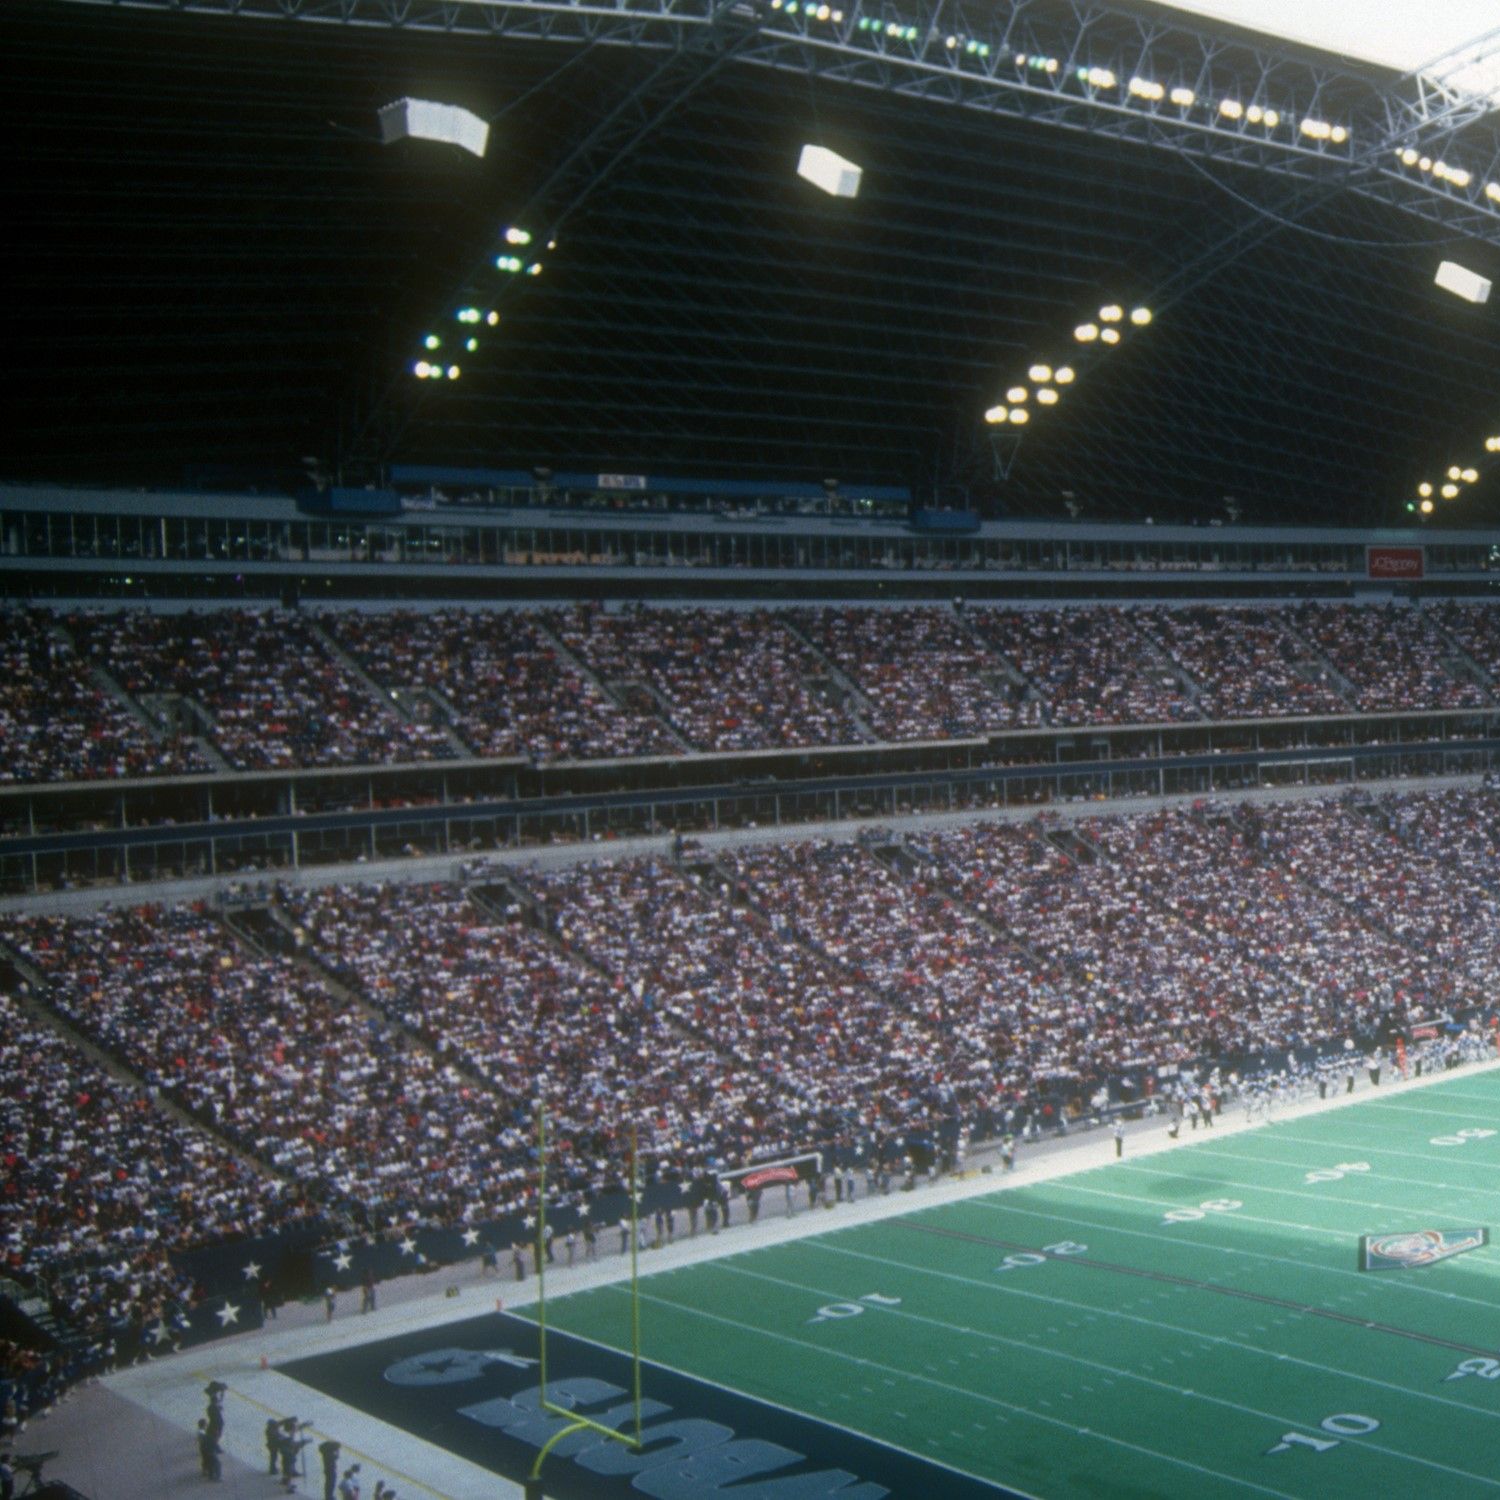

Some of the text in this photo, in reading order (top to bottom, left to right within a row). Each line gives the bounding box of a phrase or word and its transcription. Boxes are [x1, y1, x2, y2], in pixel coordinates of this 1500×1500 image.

[1003, 1241, 1088, 1266] 20
[817, 1293, 902, 1318] 10
[1282, 1414, 1379, 1451] 10
